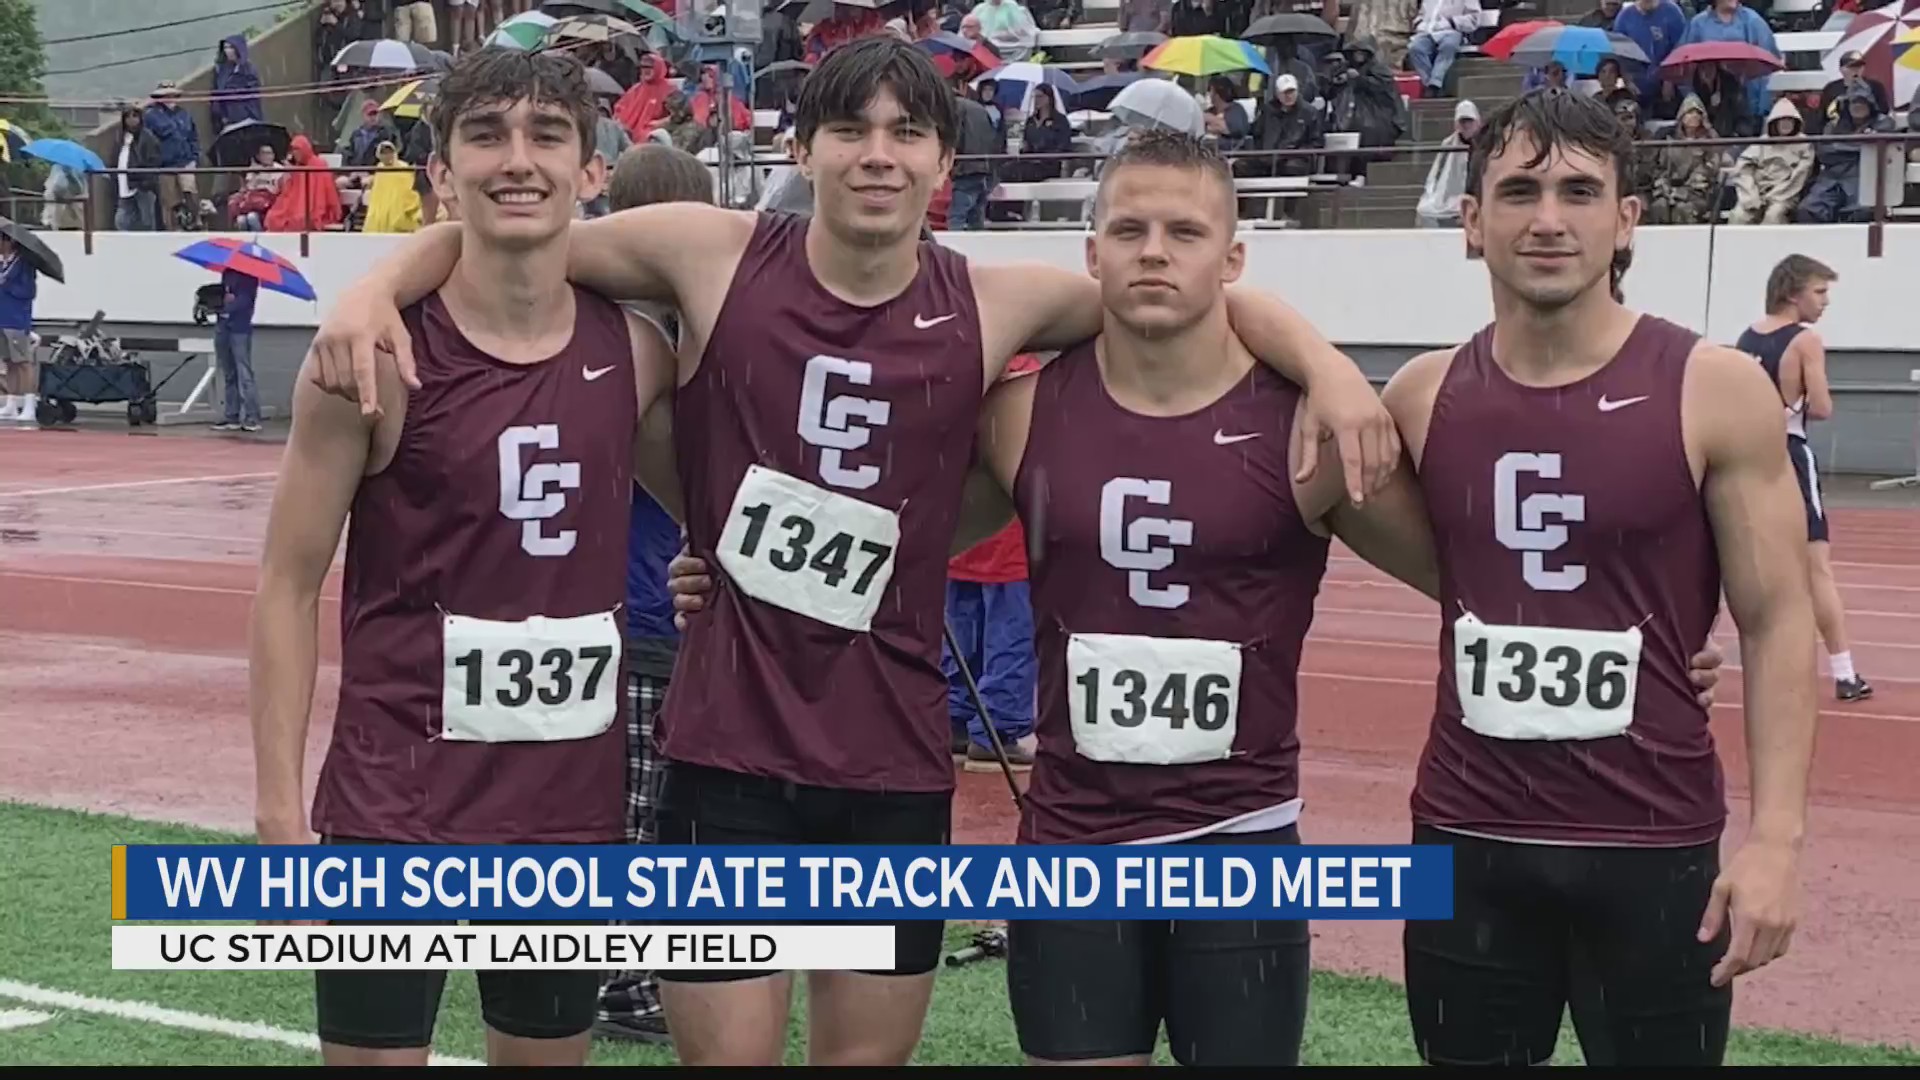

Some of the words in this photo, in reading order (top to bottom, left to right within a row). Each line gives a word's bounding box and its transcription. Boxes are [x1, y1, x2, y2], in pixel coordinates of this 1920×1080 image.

[739, 502, 893, 596] 1347
[455, 645, 613, 708] 1337
[1076, 667, 1231, 731] 1346
[1464, 637, 1629, 710] 1336
